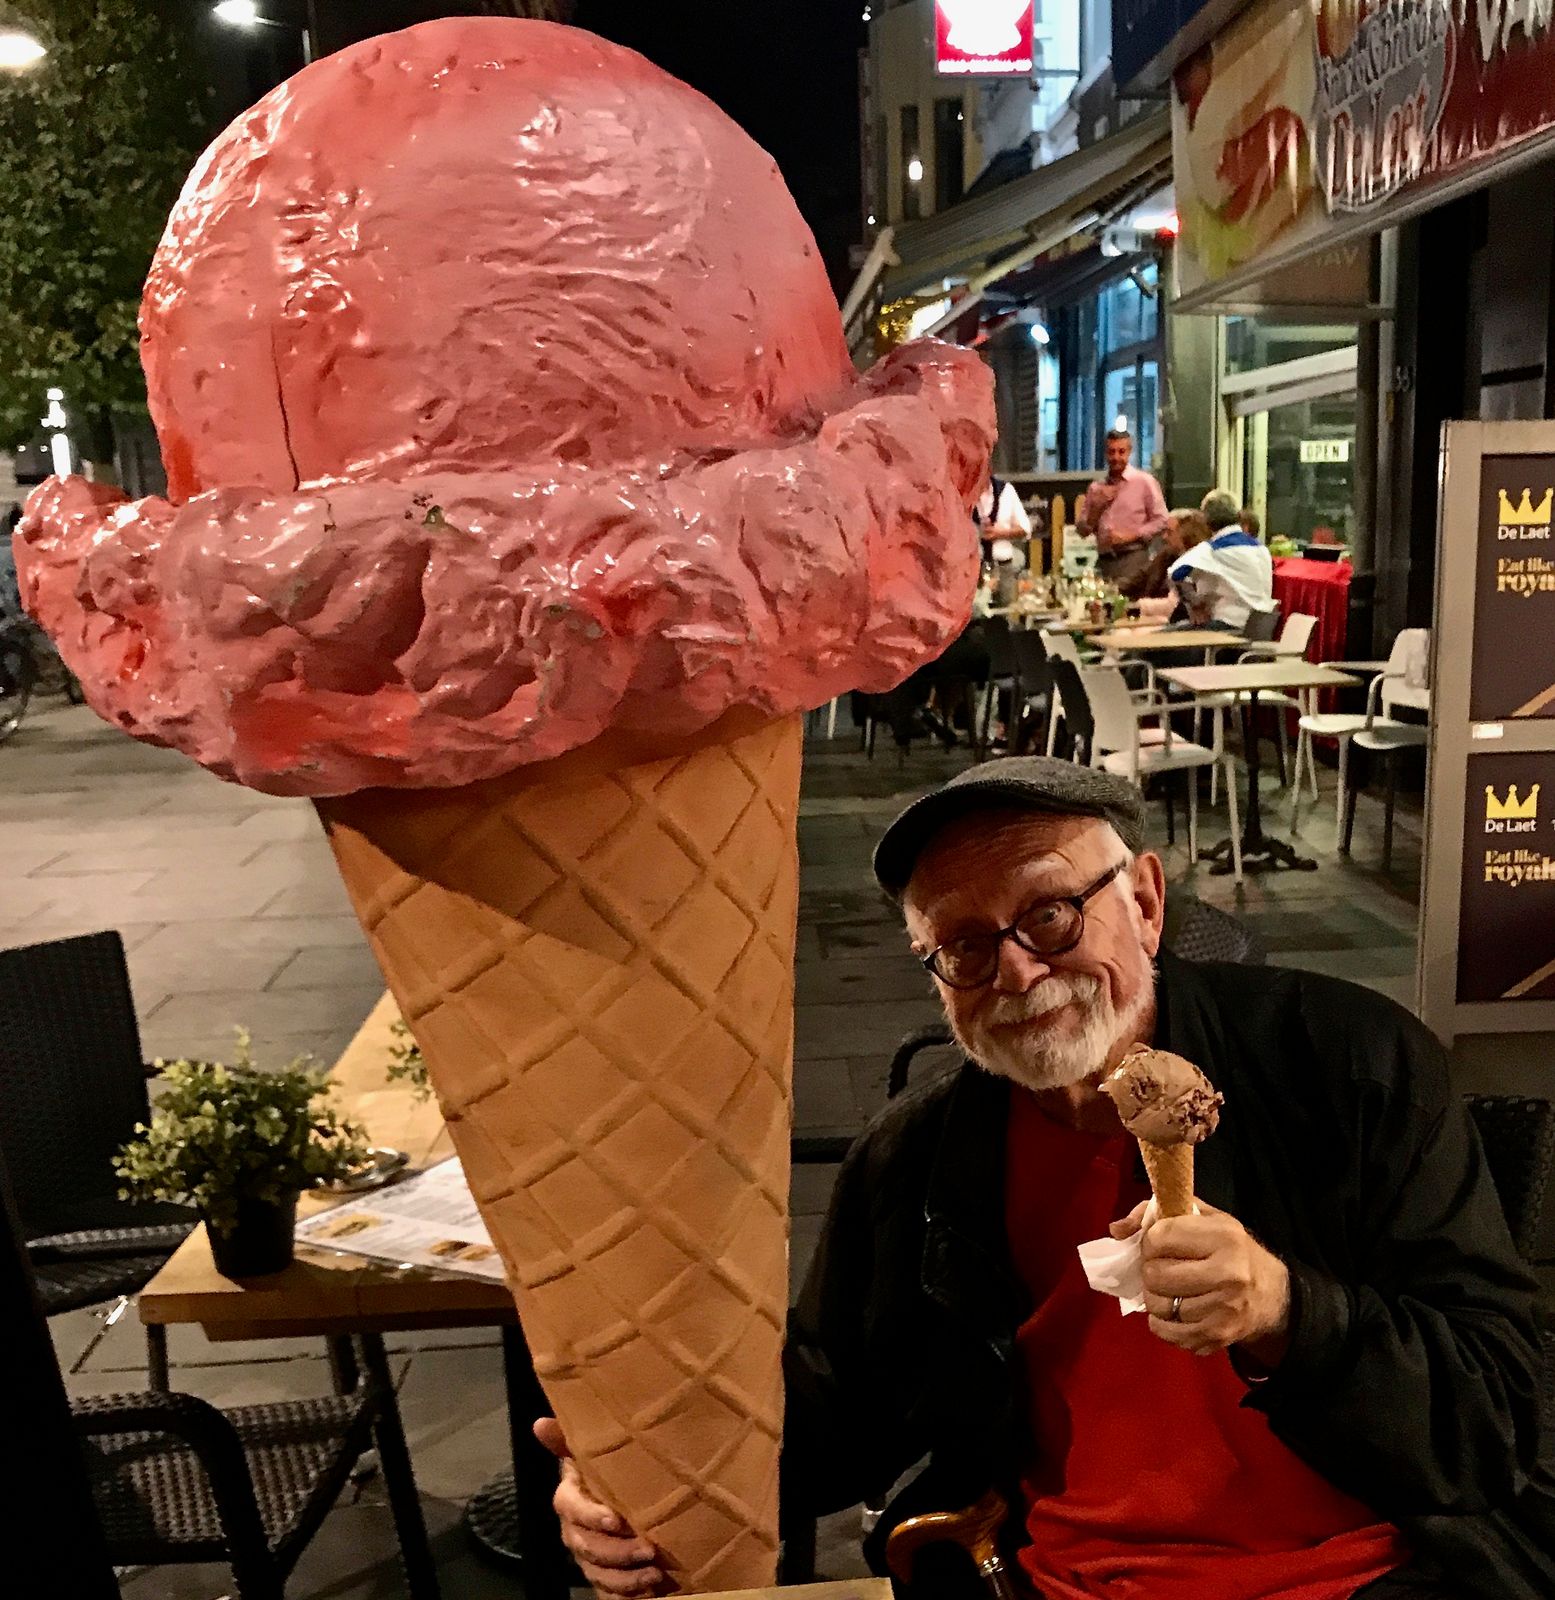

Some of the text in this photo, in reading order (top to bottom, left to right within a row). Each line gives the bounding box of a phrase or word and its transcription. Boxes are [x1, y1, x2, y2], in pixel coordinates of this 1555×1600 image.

[1306, 444, 1339, 459] OPEN
[1498, 525, 1551, 540] De Laet
[1498, 557, 1555, 573] Eat like
[1485, 819, 1504, 833] De
[1506, 819, 1537, 832] Laet
[1485, 849, 1540, 864] Eat like
